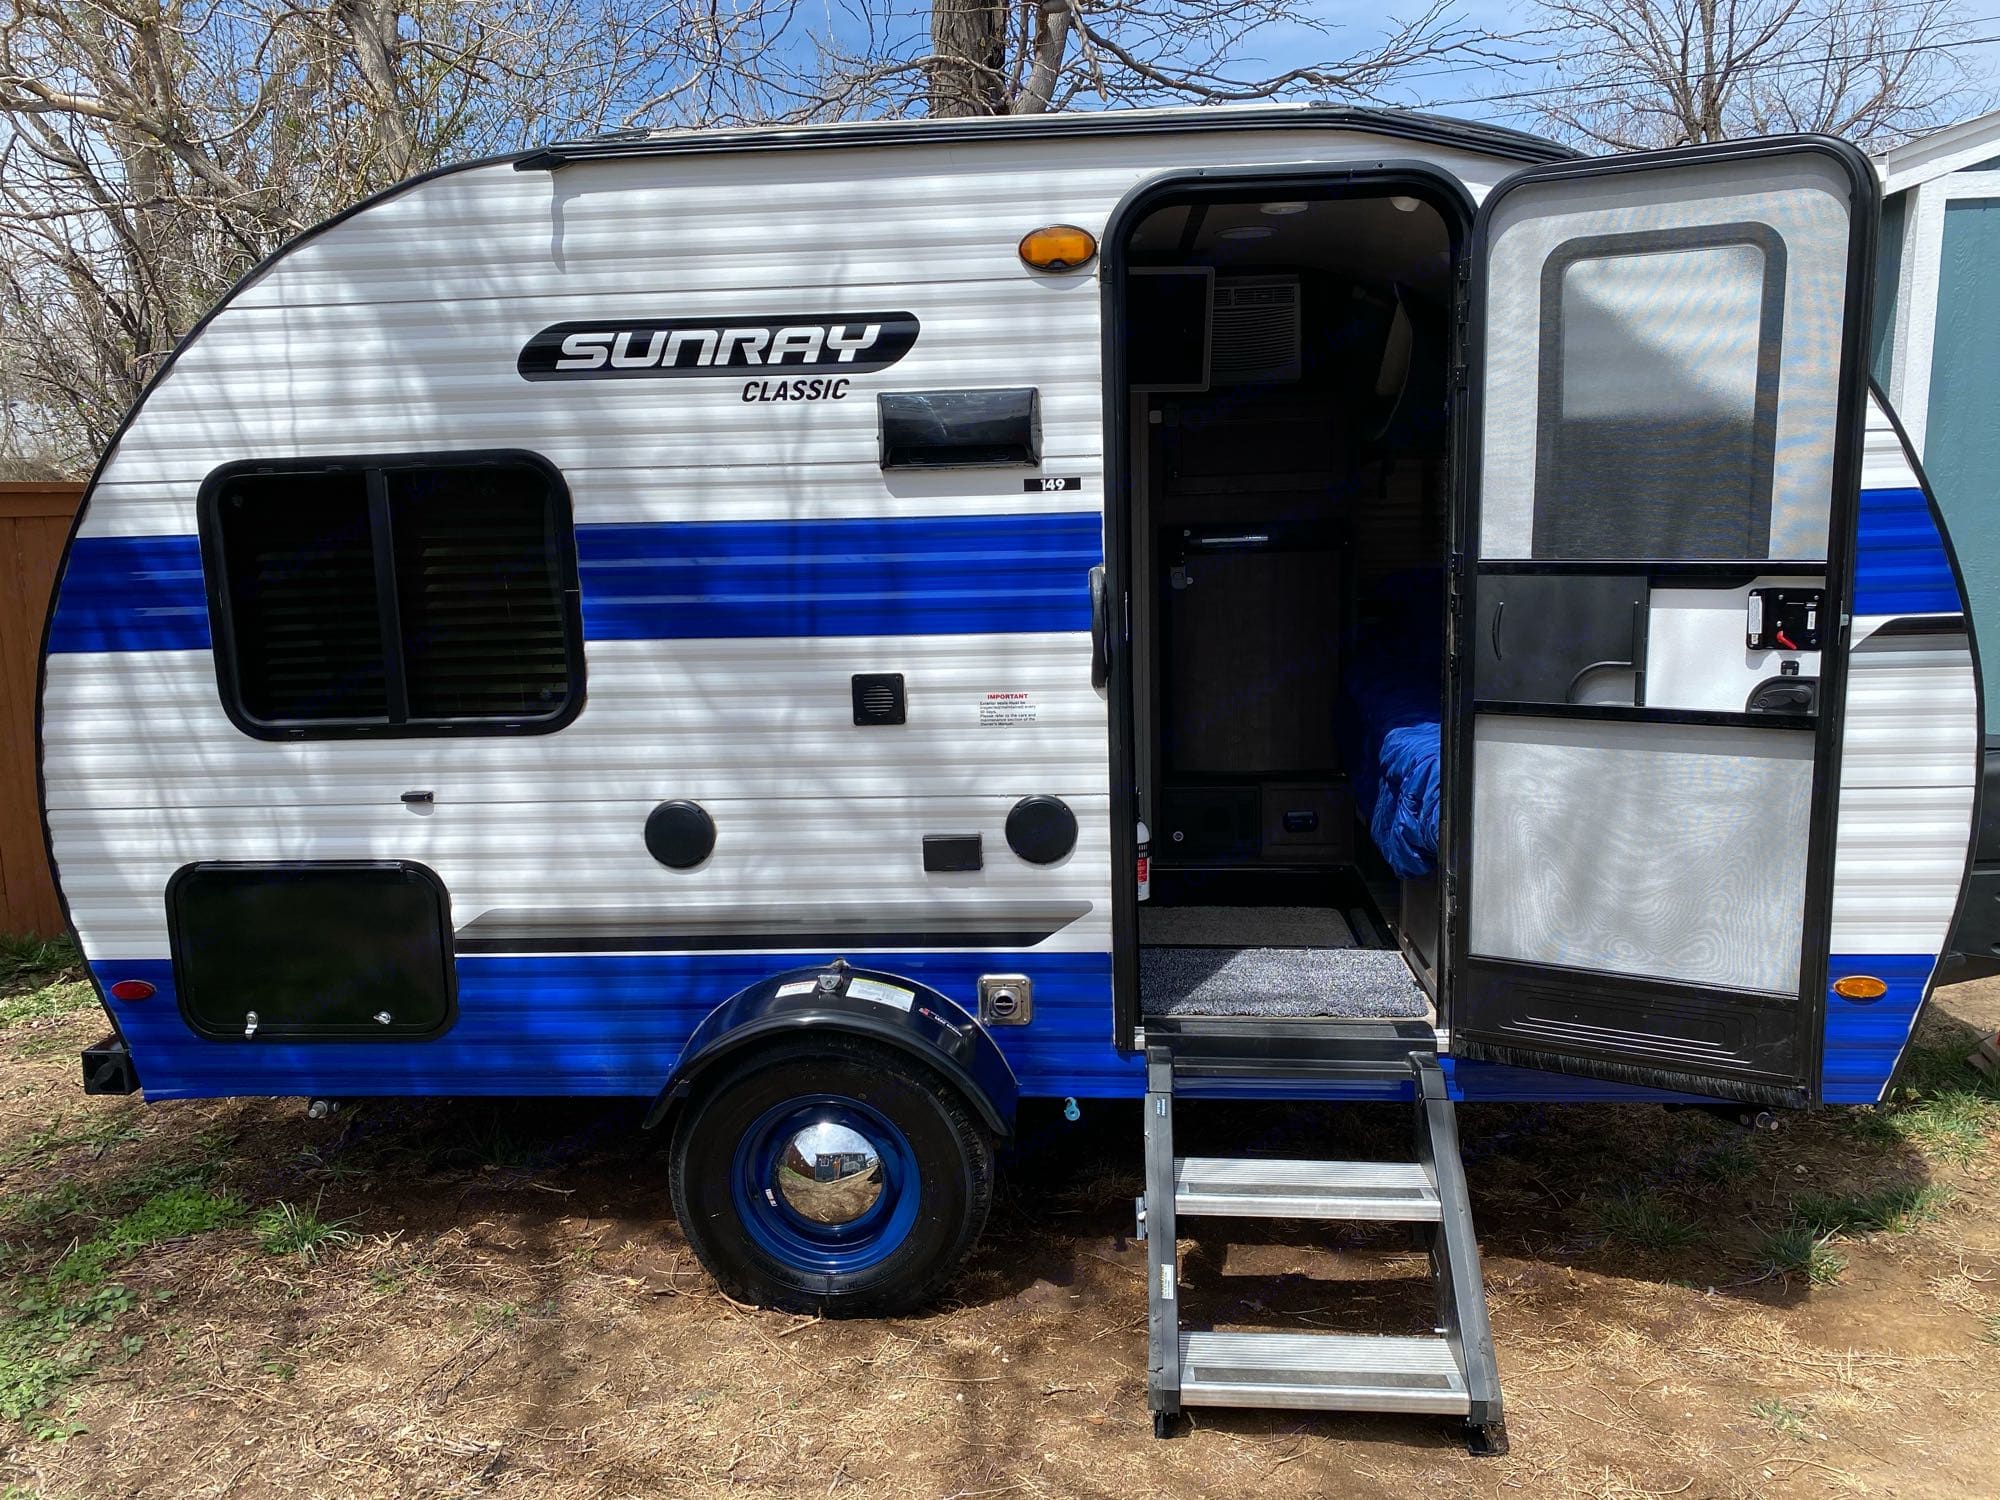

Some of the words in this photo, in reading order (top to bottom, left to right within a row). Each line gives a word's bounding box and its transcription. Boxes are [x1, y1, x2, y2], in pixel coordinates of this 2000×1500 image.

[555, 324, 882, 370] SUNRAY
[741, 378, 851, 402] CLASSIC
[1040, 478, 1066, 491] 149
